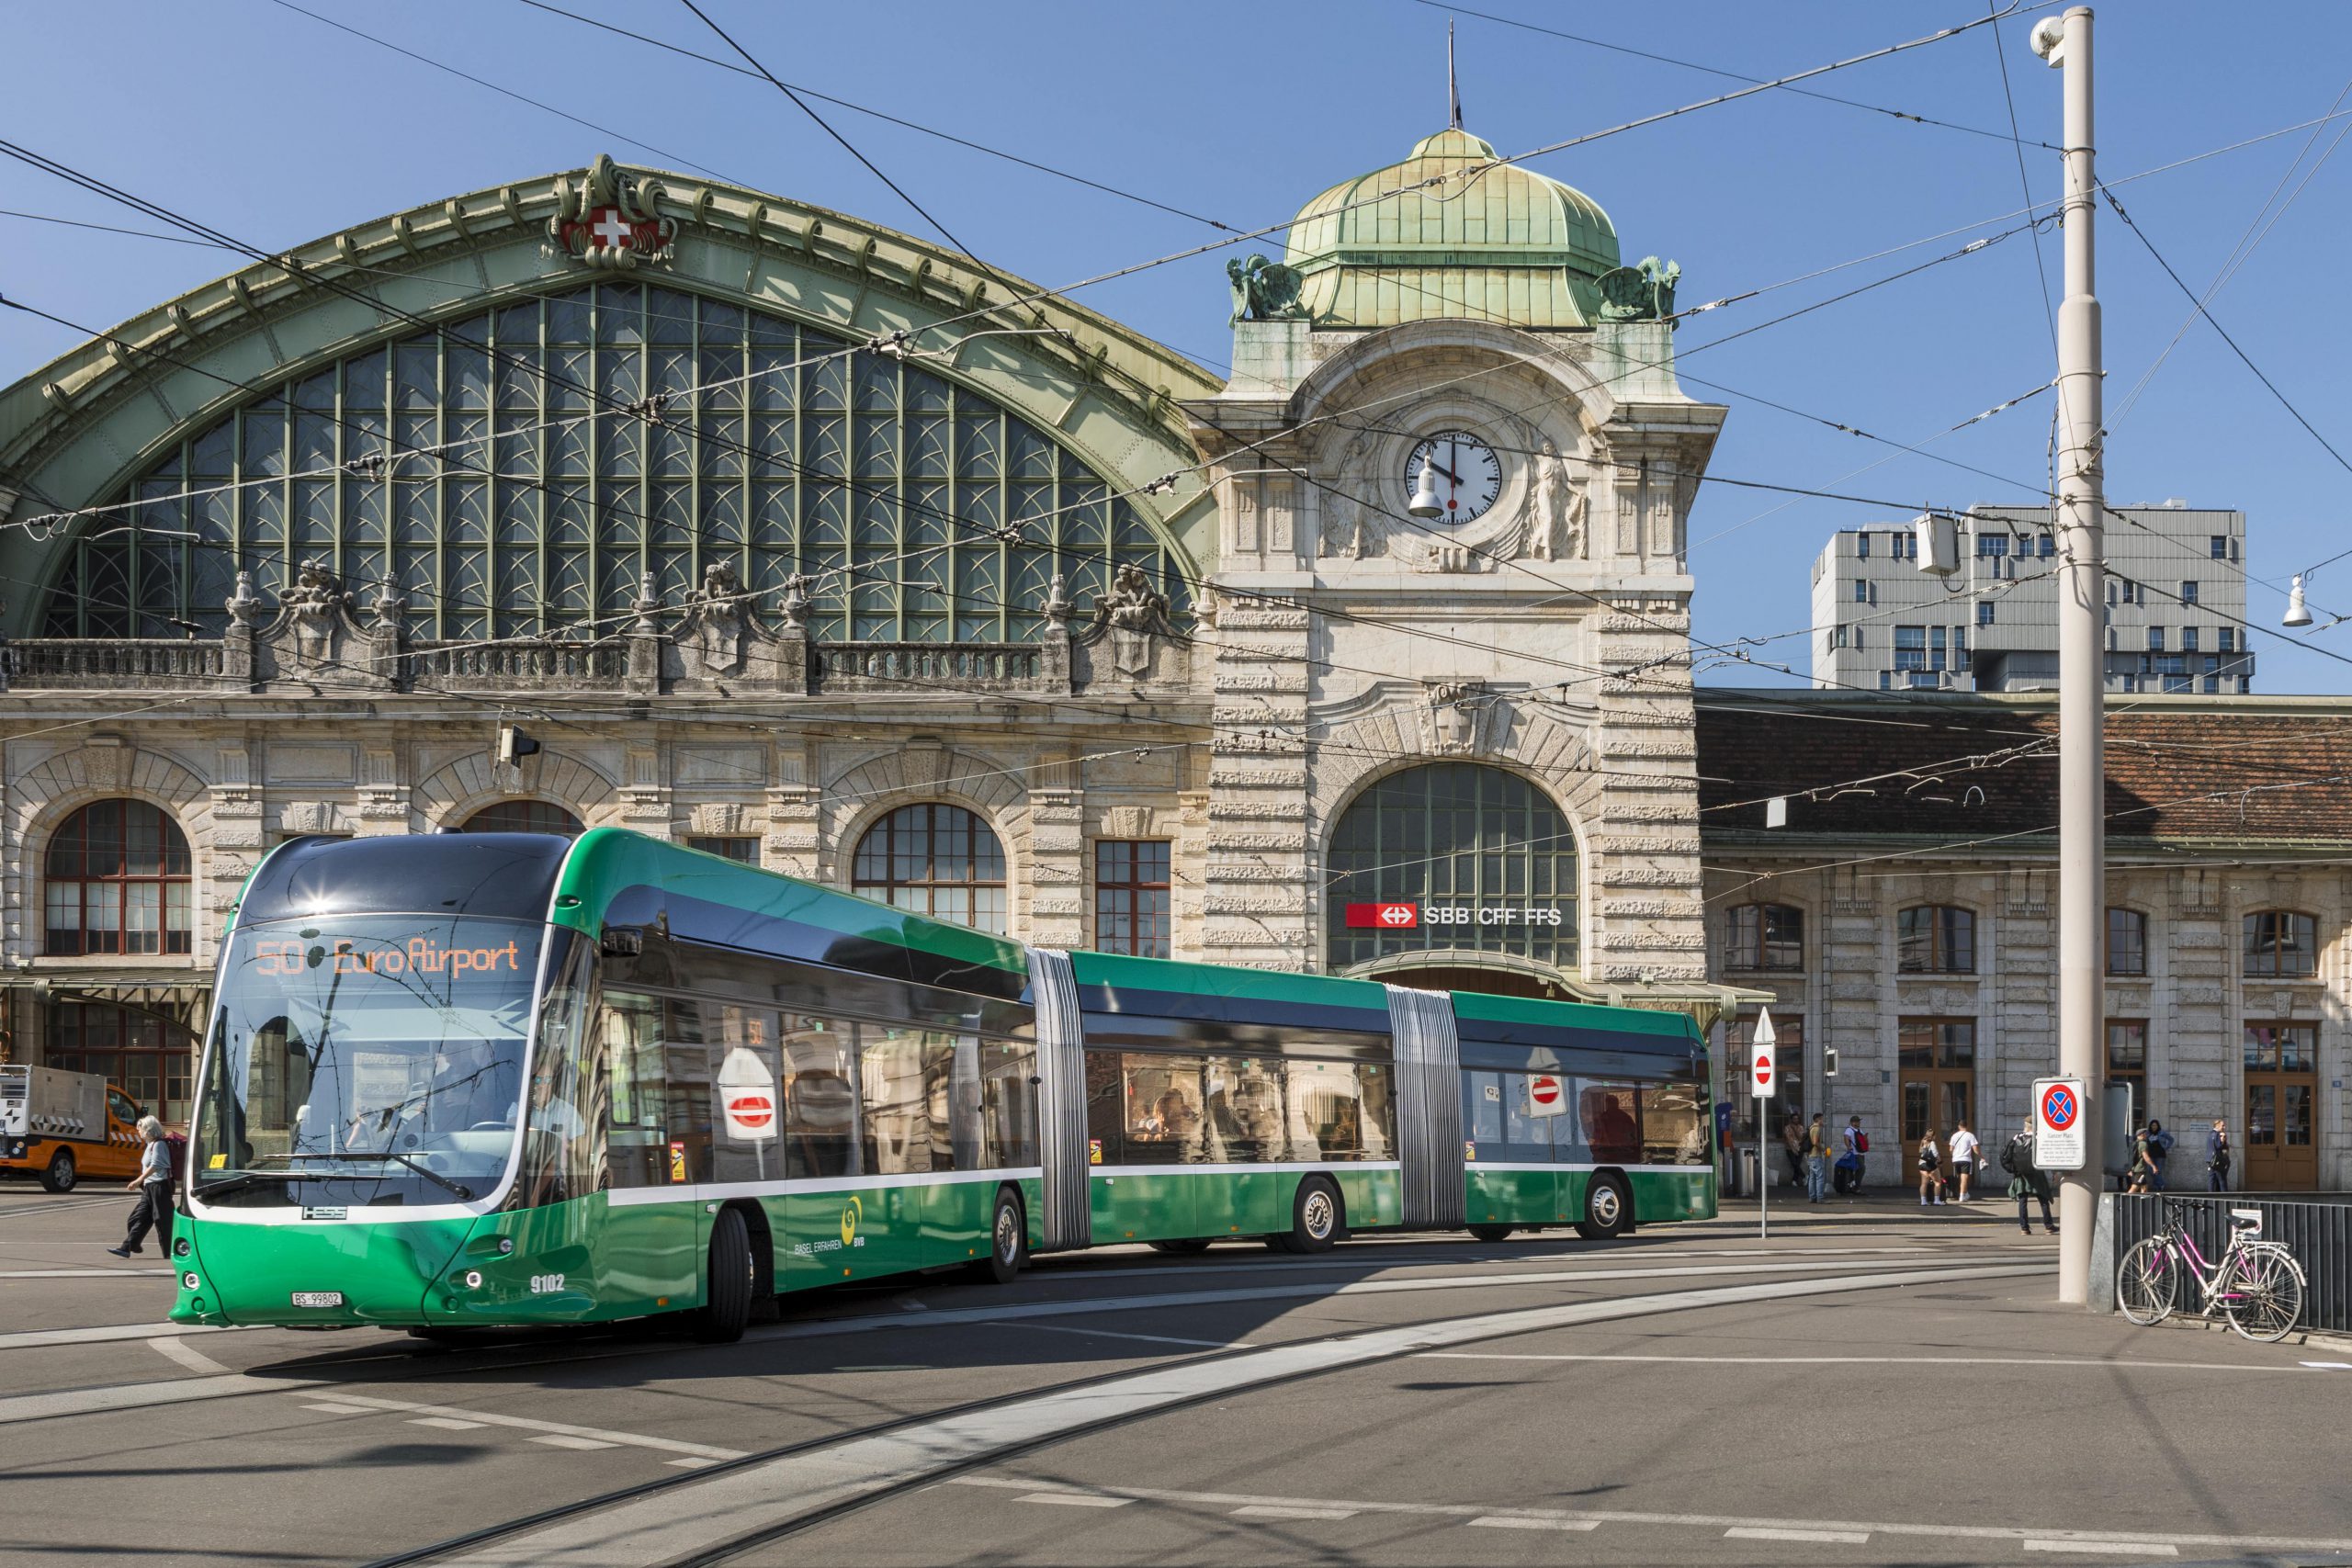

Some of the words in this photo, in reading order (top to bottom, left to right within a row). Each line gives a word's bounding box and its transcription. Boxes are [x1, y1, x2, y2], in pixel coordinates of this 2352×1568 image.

[1425, 907, 1469, 925] SBB
[1478, 908, 1516, 925] CFF
[1525, 908, 1562, 926] FFS
[255, 941, 304, 975] 50
[334, 938, 518, 978] EuroAirport
[749, 1020, 763, 1044] 50
[303, 1206, 347, 1219] HESS
[795, 1243, 813, 1256] BASEL
[814, 1239, 842, 1252] ERFAHREN
[854, 1236, 865, 1247] BVB
[530, 1273, 565, 1293] 9102
